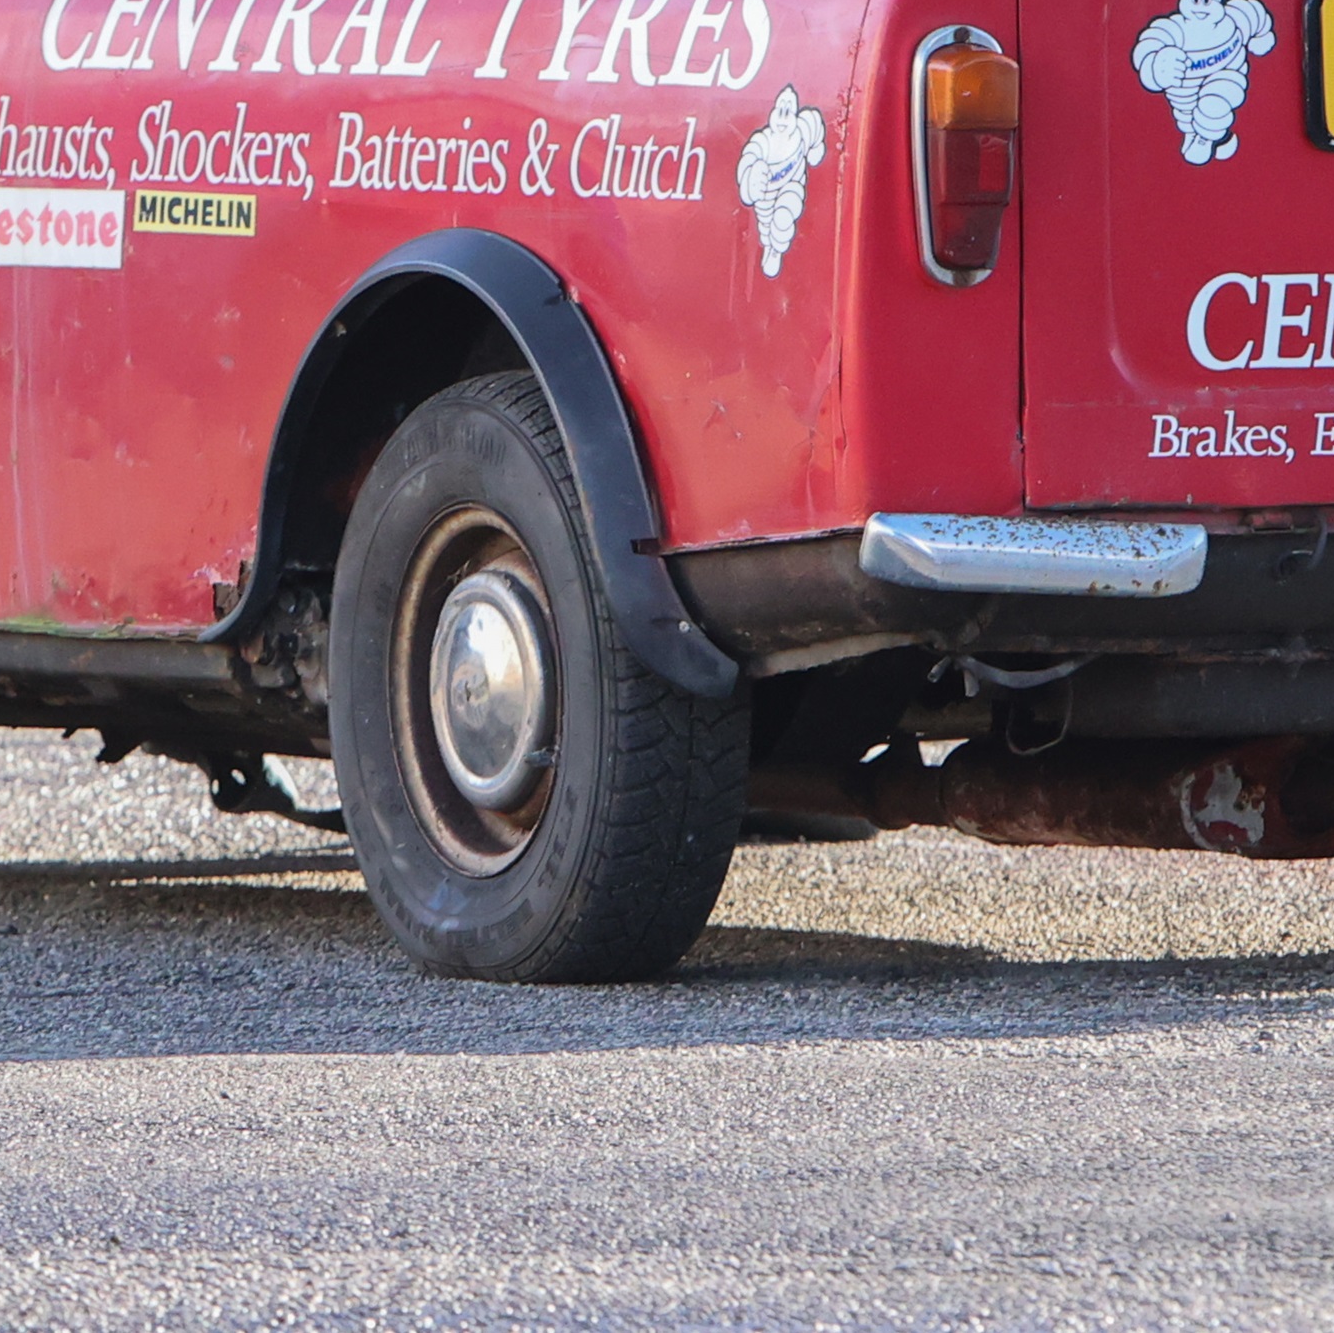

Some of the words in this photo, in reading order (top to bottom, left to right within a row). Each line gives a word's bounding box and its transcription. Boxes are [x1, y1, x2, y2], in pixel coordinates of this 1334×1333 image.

[1190, 37, 1240, 71] MICHELIN
[130, 101, 315, 201] Shockers,
[329, 112, 507, 195] Batteries
[519, 117, 560, 197] &
[569, 114, 707, 201] Clutch
[138, 195, 253, 230] MICHELIN
[1148, 410, 1295, 463] Brakes,
